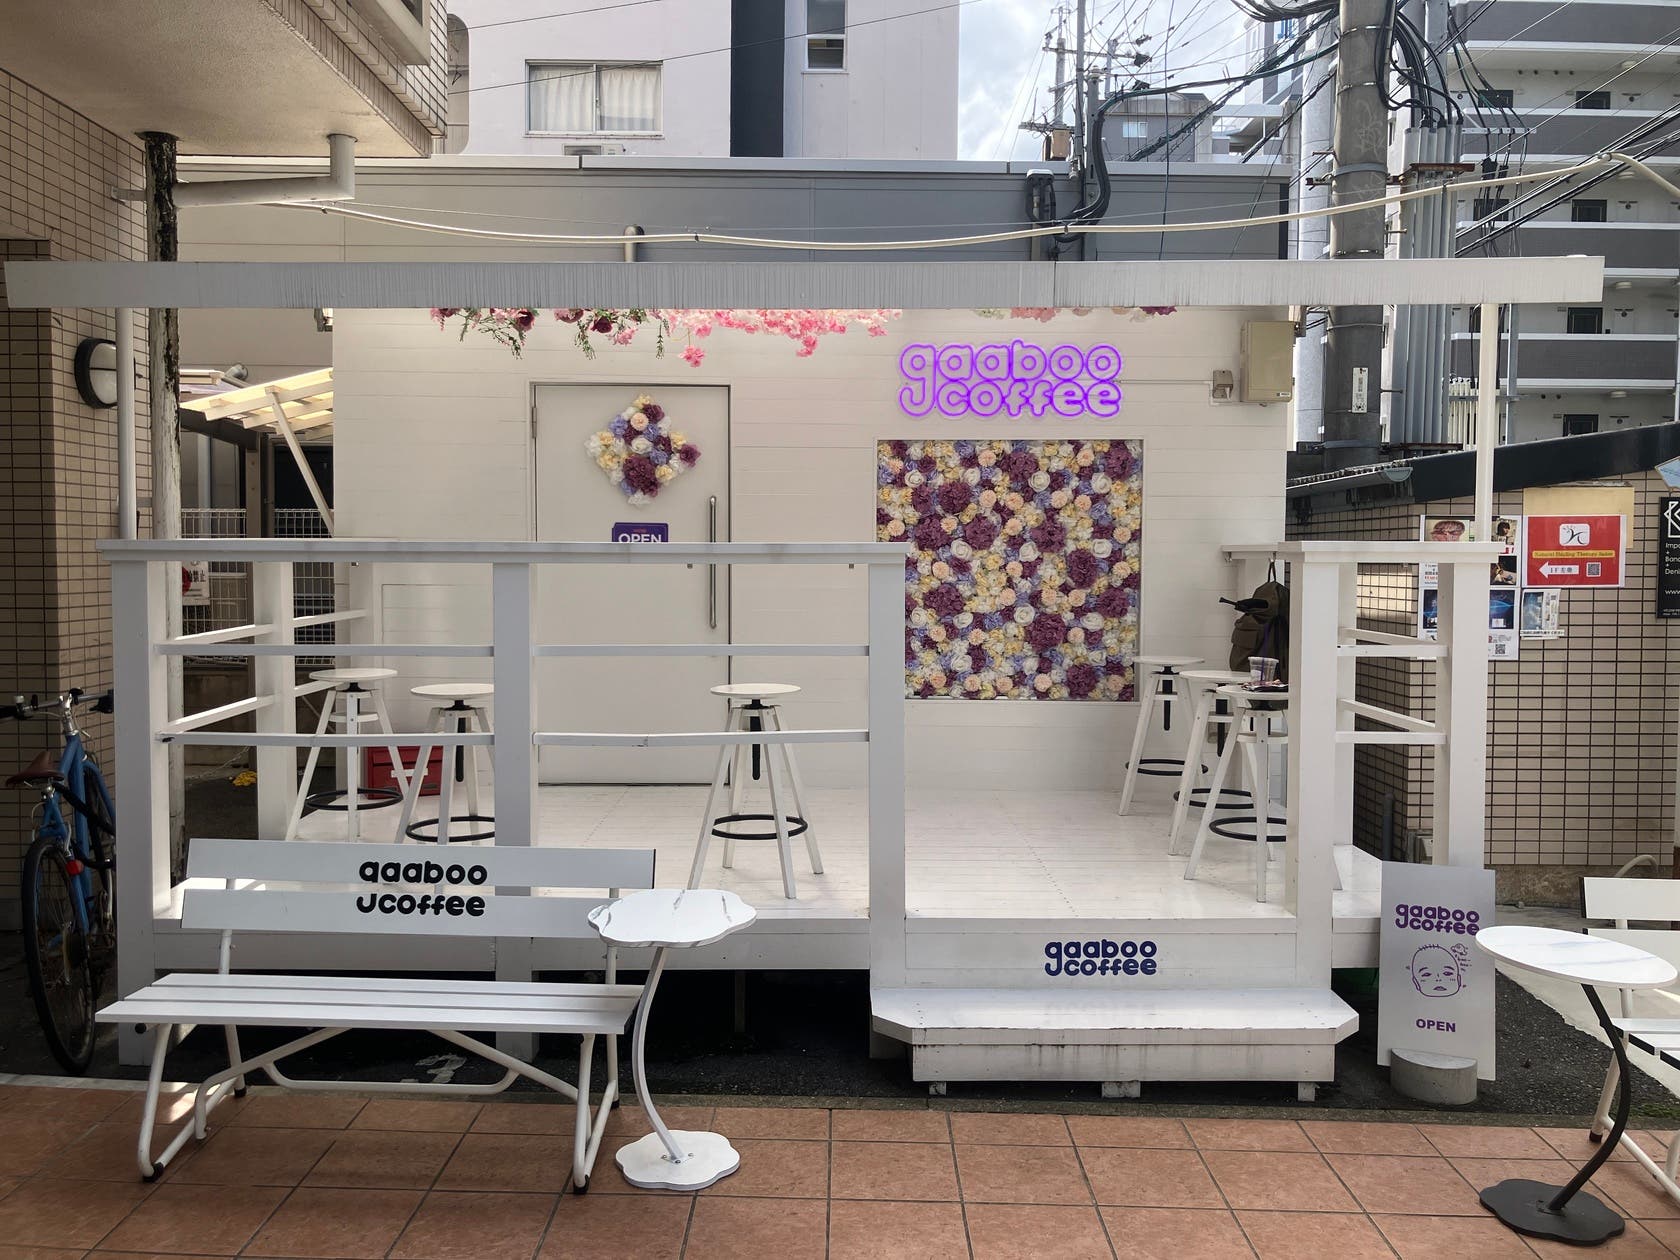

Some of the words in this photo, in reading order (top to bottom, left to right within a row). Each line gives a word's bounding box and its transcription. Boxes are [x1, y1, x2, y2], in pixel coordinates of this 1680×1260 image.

[898, 338, 1123, 418] gaaboo
[936, 381, 1123, 418] coffee
[618, 533, 662, 543] OPEN
[1395, 904, 1480, 929] gaaboo
[1409, 918, 1480, 936] coffee
[1044, 939, 1157, 976] gaaboo
[1064, 958, 1157, 976] coffee
[1416, 1018, 1456, 1033] OPEN
